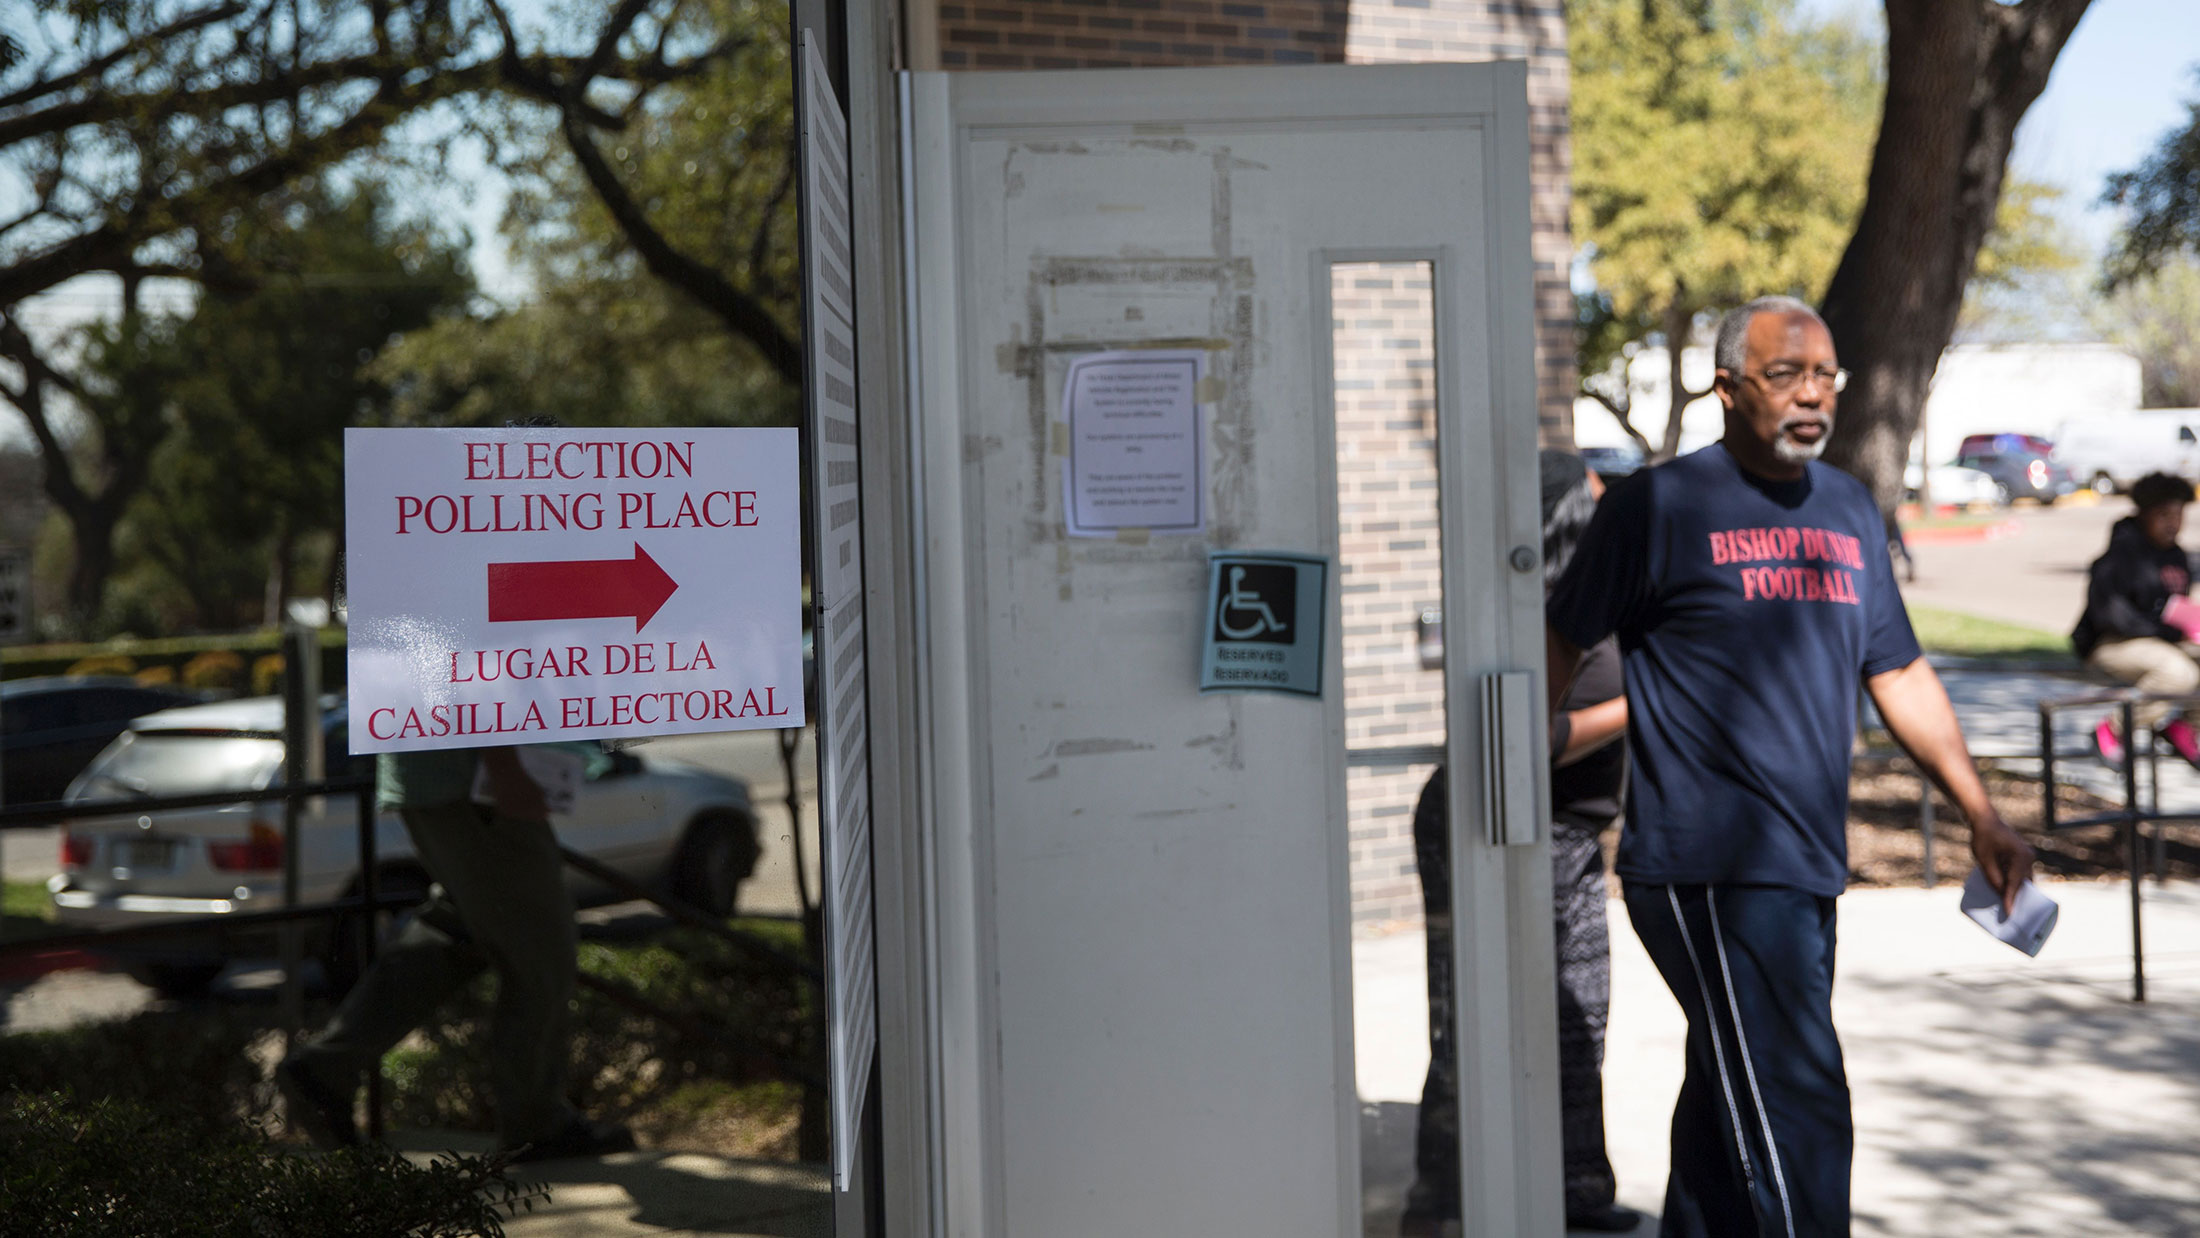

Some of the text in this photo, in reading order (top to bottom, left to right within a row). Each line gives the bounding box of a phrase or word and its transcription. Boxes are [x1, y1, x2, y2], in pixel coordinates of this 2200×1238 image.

[464, 441, 695, 480] ELECTION
[396, 491, 759, 534] POLLING PLACE
[1709, 527, 1800, 566] BISHOP
[1740, 566, 1860, 605] FOOTBALL
[450, 640, 716, 683] LUGAR DE LA
[1217, 647, 1286, 664] RESERVED
[368, 687, 788, 740] CASILLA ELECTORAL
